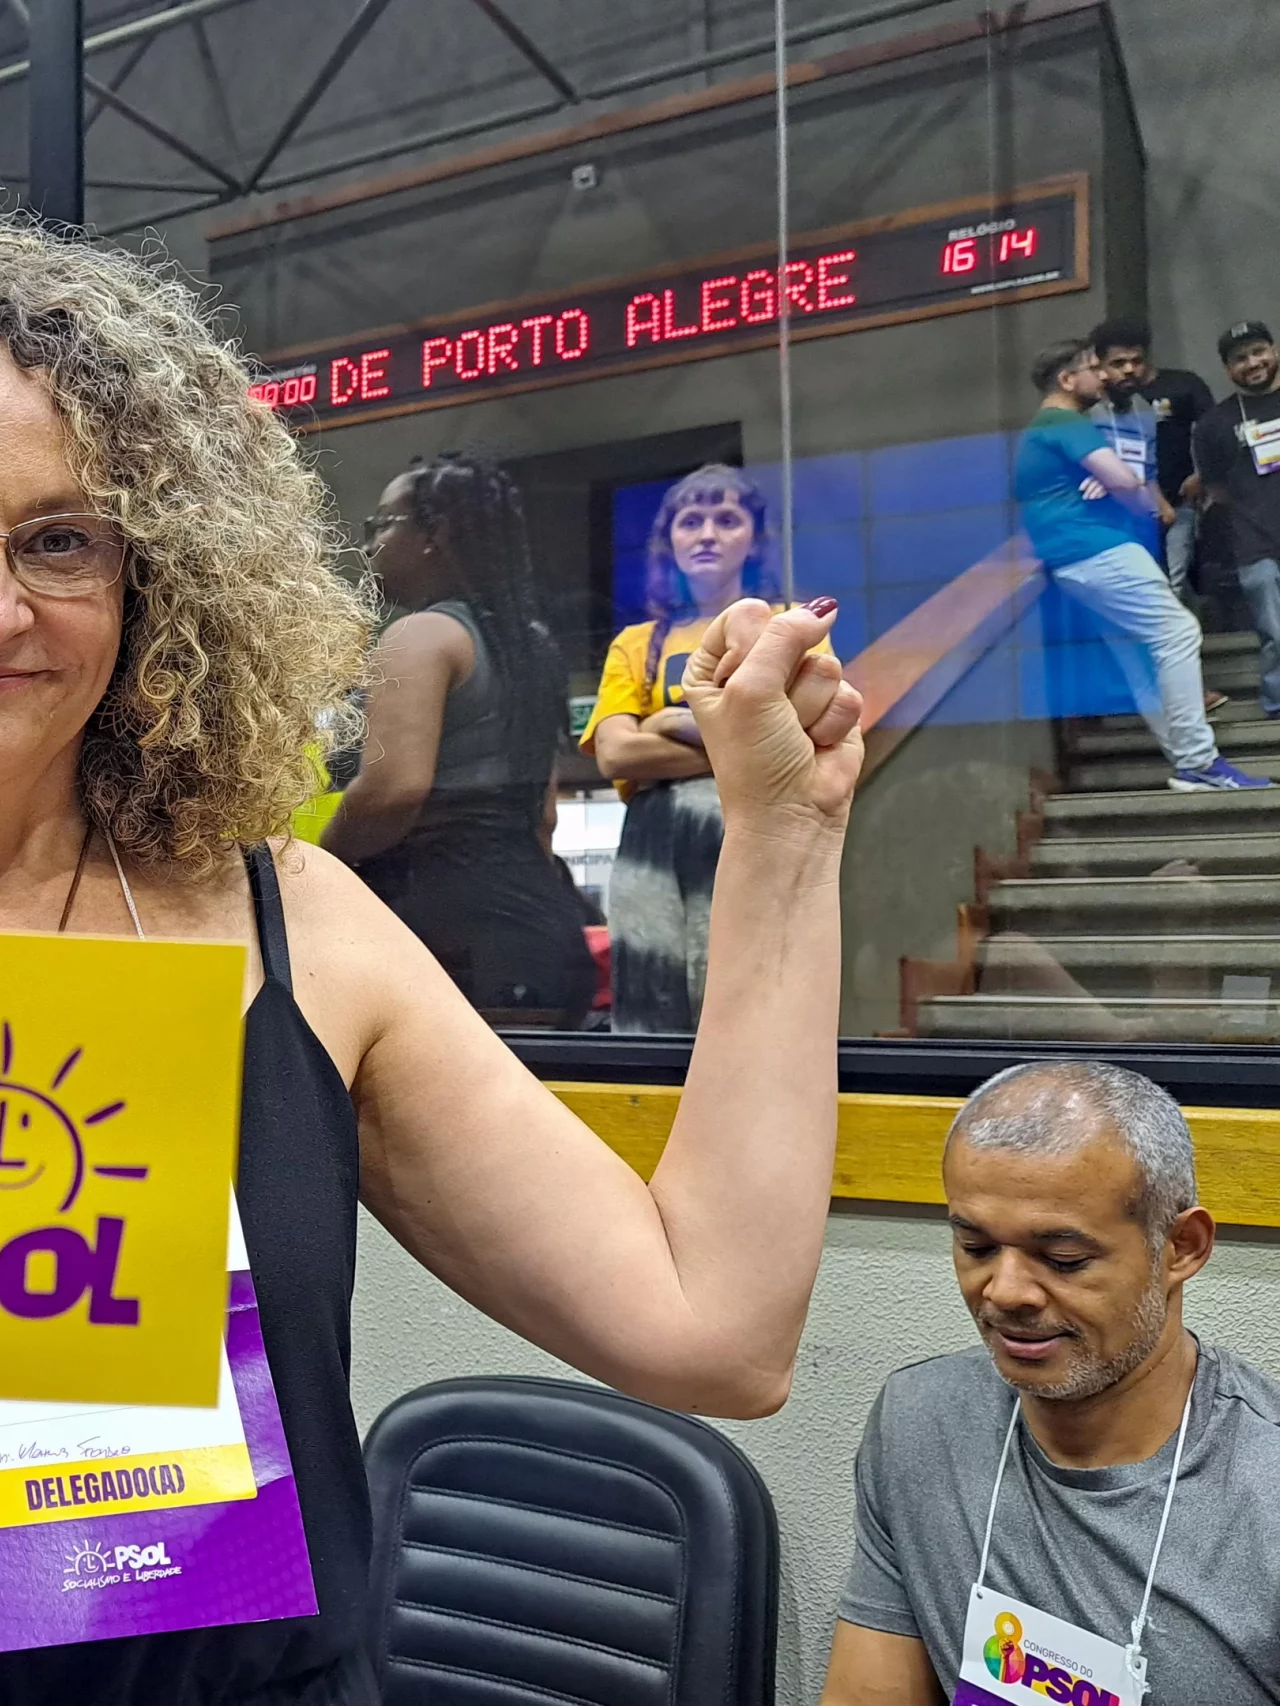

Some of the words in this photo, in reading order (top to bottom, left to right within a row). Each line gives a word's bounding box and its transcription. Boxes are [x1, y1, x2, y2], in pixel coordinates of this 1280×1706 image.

[331, 349, 391, 406] DE
[422, 307, 589, 388] PORTO
[626, 250, 857, 348] ALEGRE
[25, 1464, 186, 1511] DELEGADO(A)
[114, 1541, 171, 1571] PSOL
[61, 1574, 121, 1592] SOCIALISMO
[123, 1572, 131, 1582] E
[1023, 1639, 1079, 1671] CONGRESSO
[1080, 1662, 1094, 1679] DO
